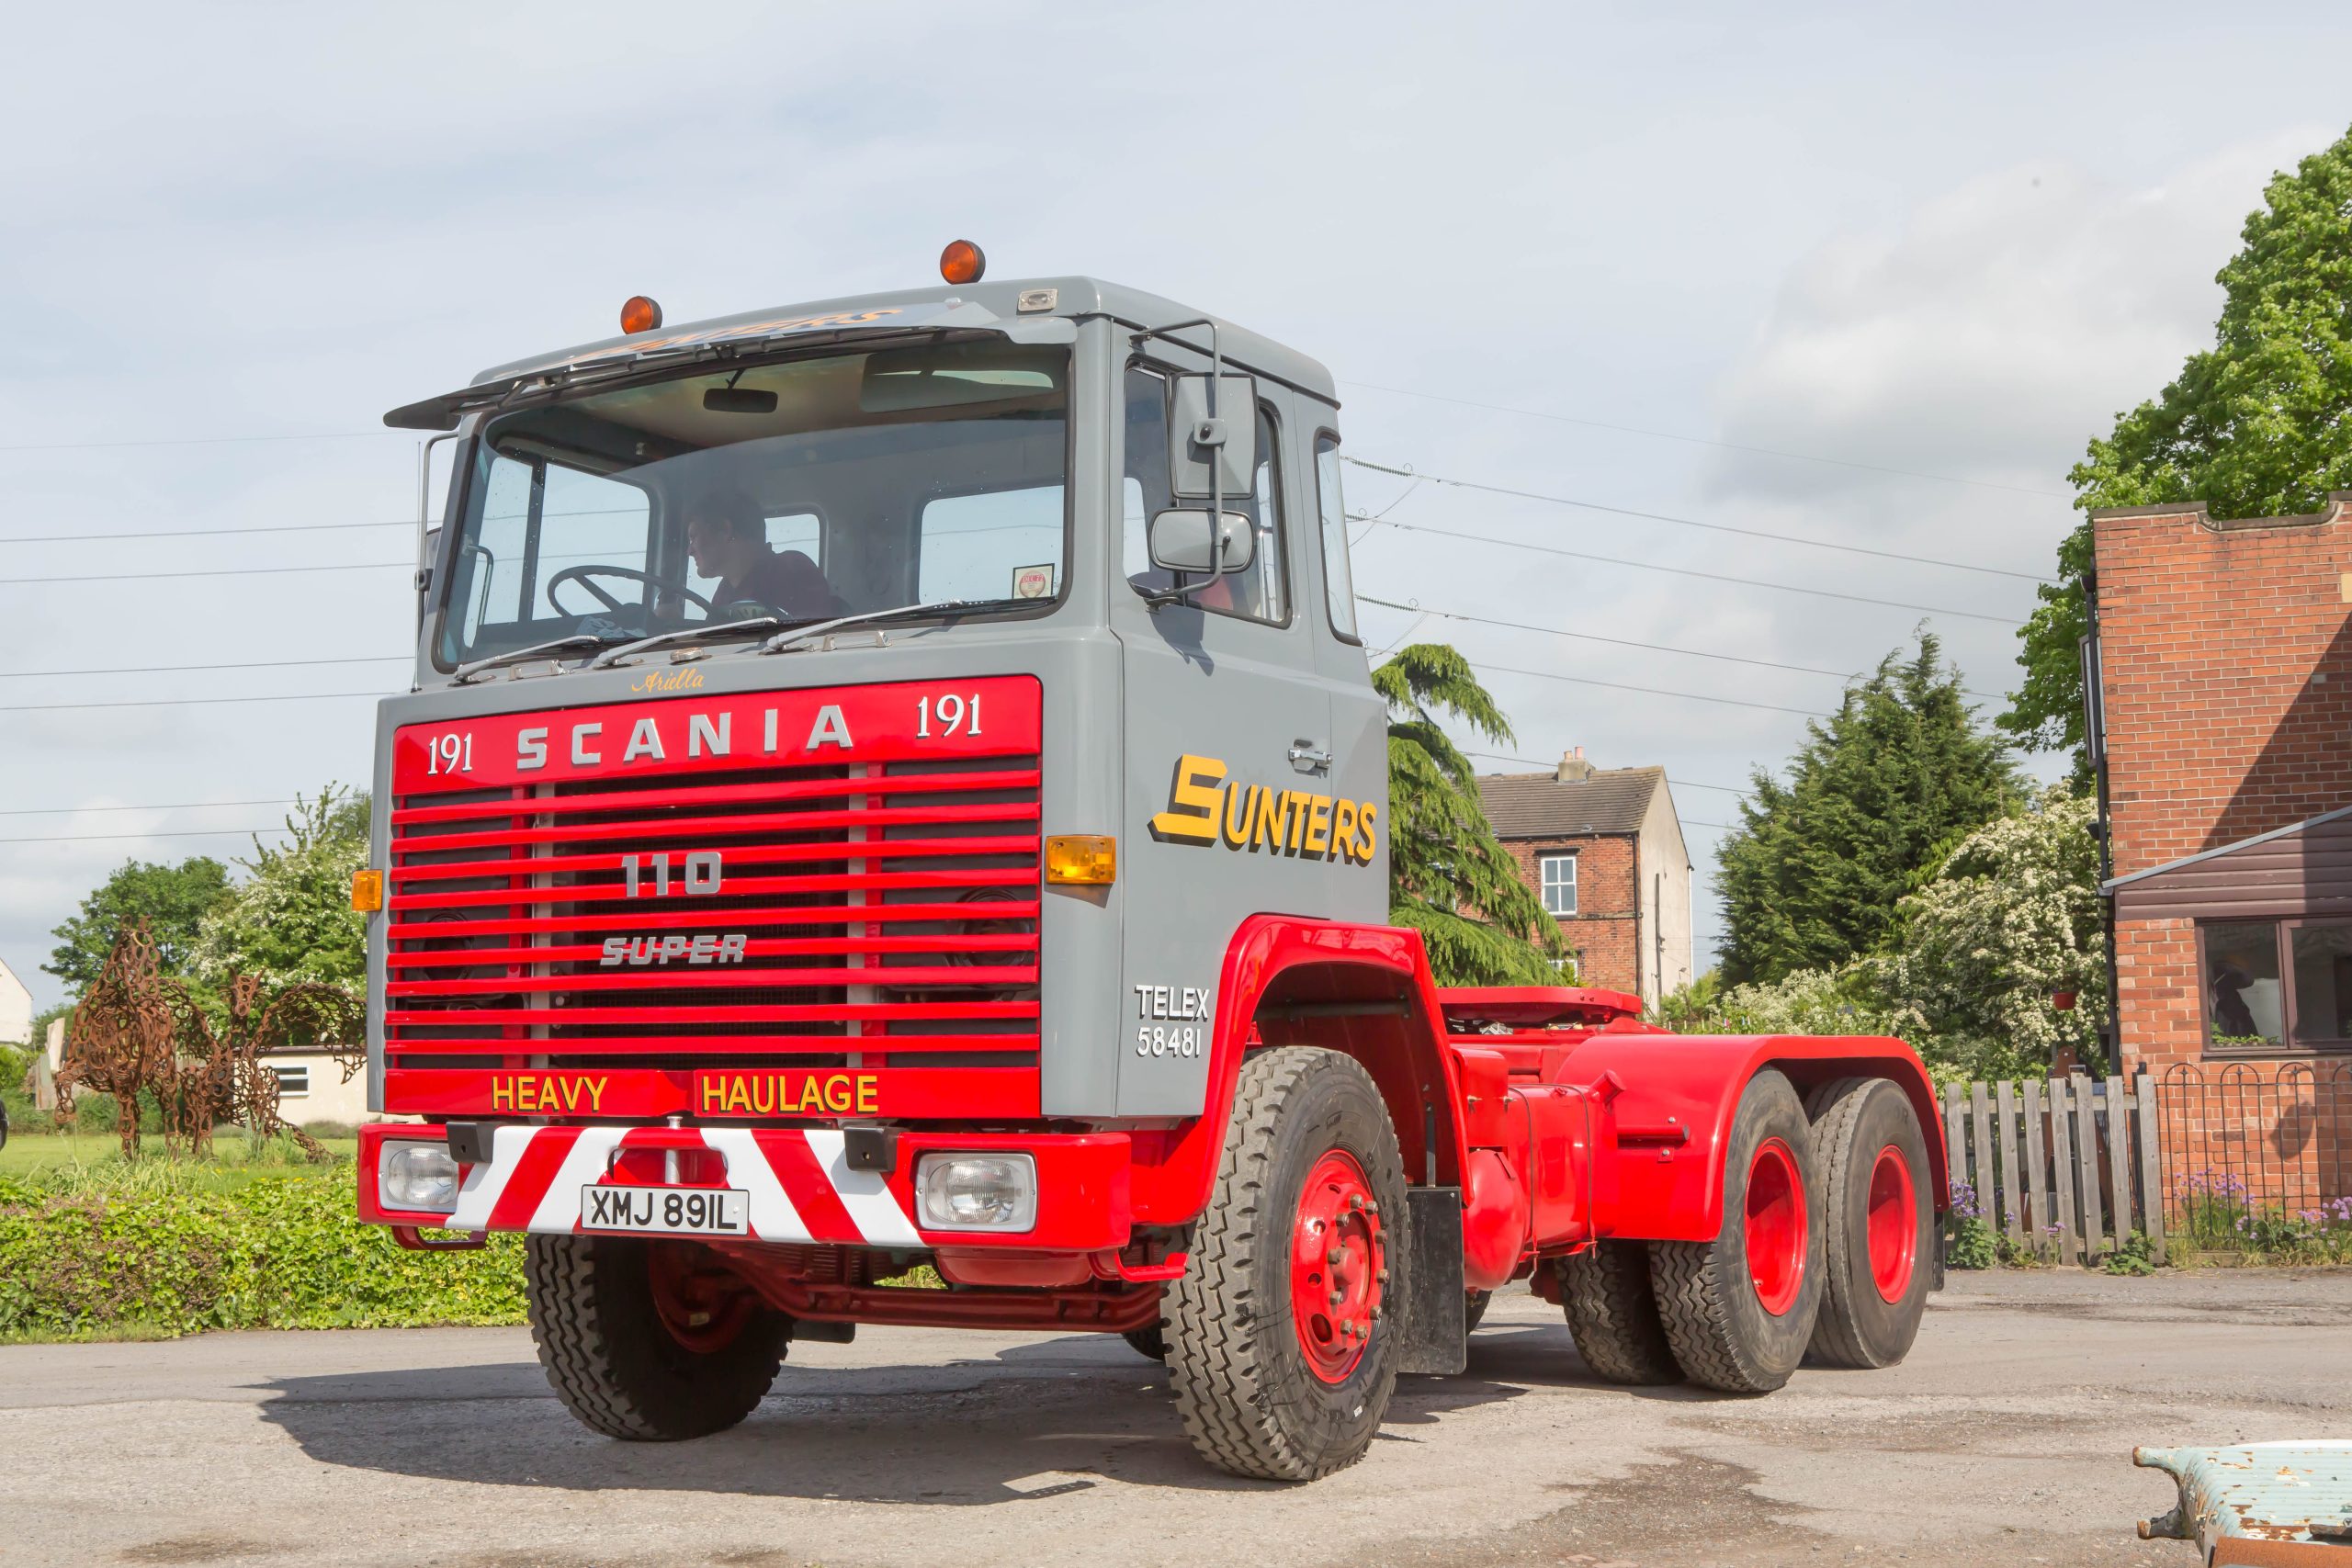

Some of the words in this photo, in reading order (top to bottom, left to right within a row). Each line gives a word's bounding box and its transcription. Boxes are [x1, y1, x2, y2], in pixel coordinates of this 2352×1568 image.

[631, 668, 705, 693] Ariella
[915, 693, 982, 739] 191
[426, 732, 473, 775] 191
[517, 705, 854, 770] SCANIA
[1147, 753, 1377, 868] SUNTERS
[621, 852, 722, 897] 110
[600, 934, 747, 965] SUPER
[1135, 985, 1210, 1021] TELEX
[1136, 1026, 1202, 1057] 58481
[492, 1077, 607, 1112] HEAVY
[702, 1075, 879, 1113] HAULAGE
[591, 1190, 653, 1226] XMJ
[663, 1193, 738, 1230] 891L
